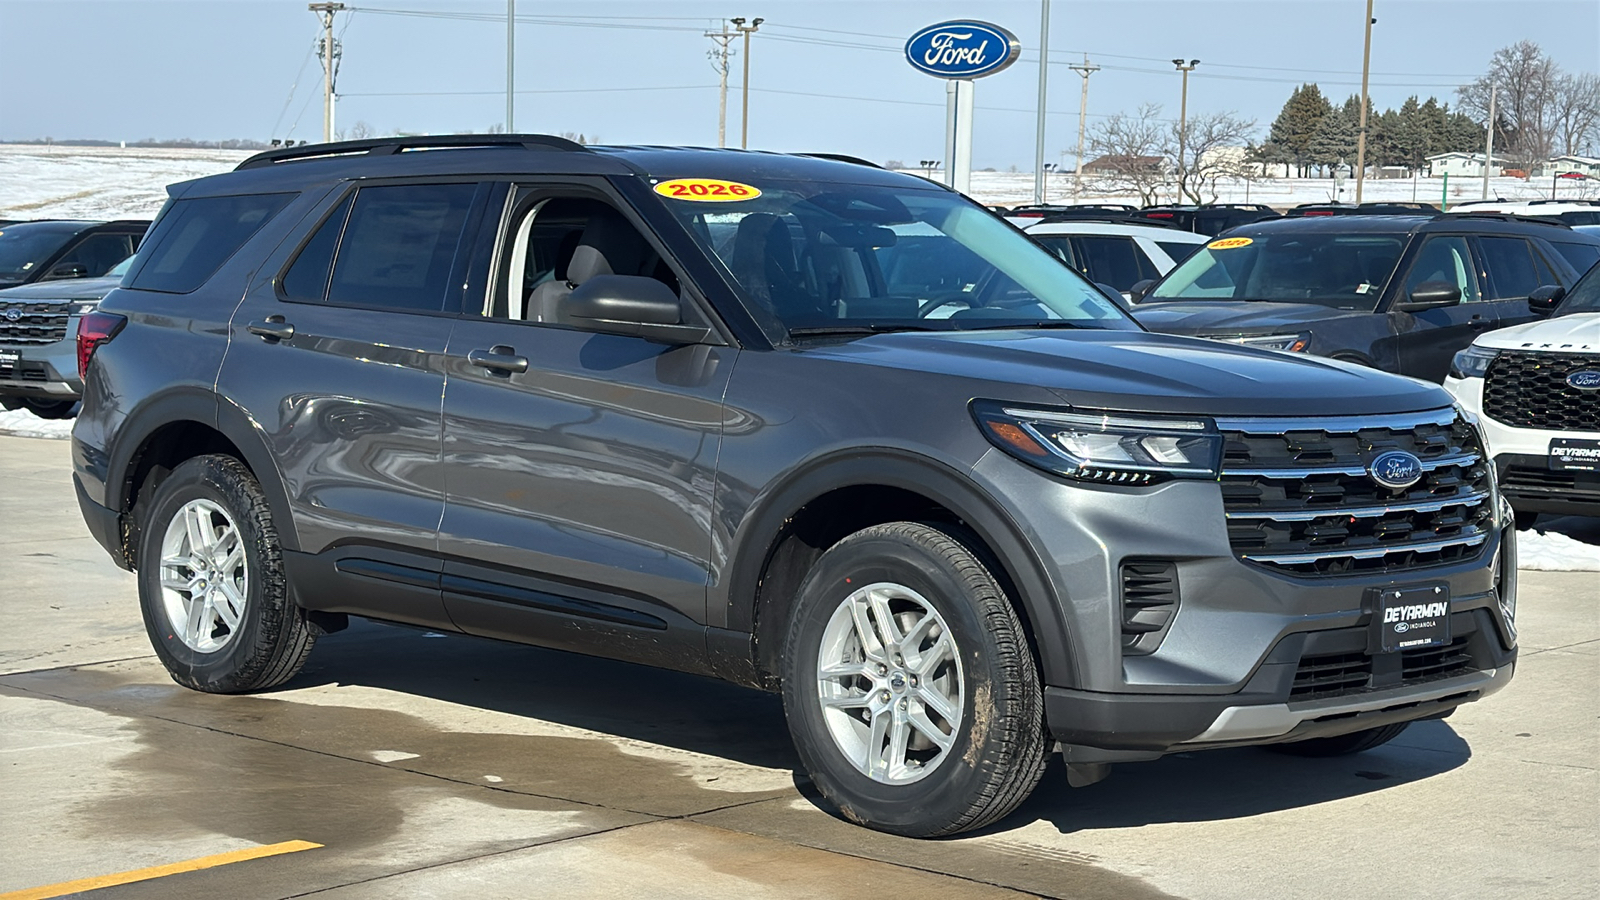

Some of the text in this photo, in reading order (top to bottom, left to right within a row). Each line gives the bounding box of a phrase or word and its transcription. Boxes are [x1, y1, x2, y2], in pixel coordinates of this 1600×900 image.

[925, 32, 988, 65] Ford
[668, 184, 749, 196] 2026
[1386, 458, 1413, 478] Ford
[1384, 602, 1447, 623] DEYARMAN
[1410, 620, 1436, 629] INDIANOLA
